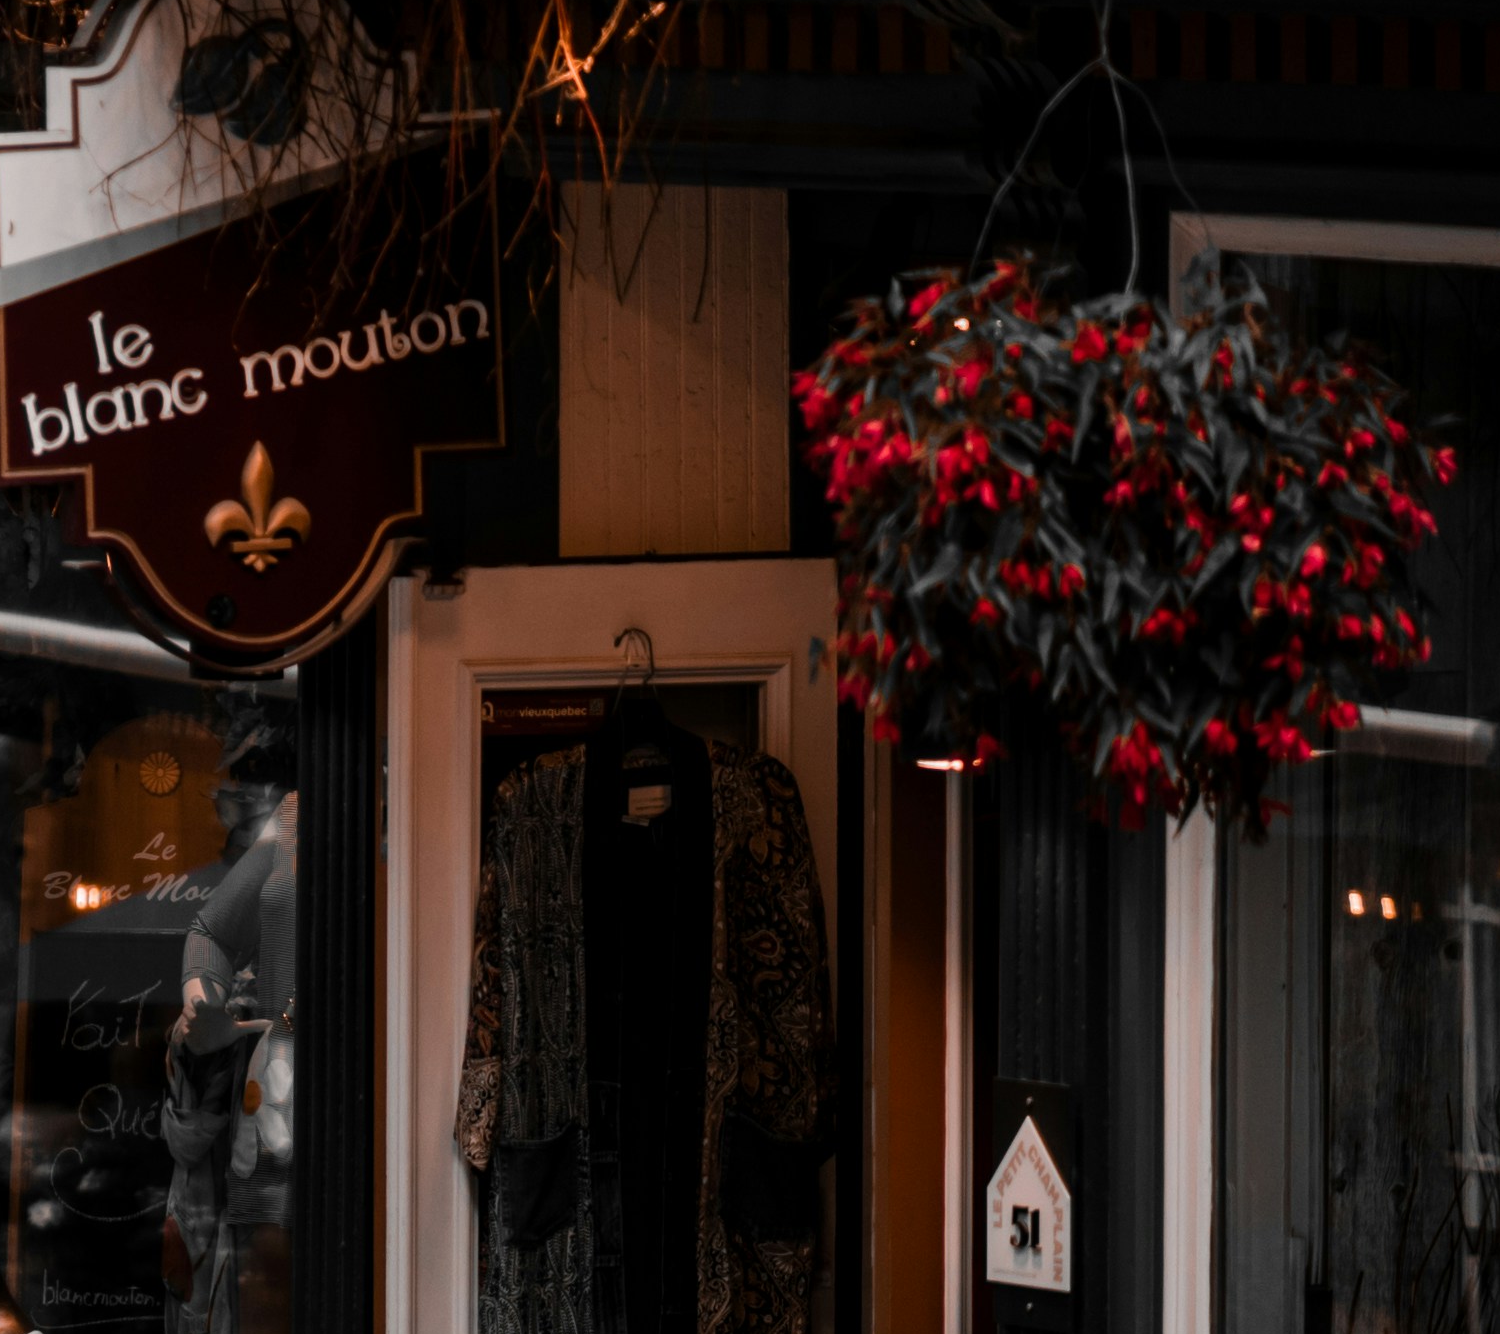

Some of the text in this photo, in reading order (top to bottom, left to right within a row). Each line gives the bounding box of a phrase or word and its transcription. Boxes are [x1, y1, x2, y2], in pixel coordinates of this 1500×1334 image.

[88, 309, 154, 375] le
[20, 298, 490, 456] blanc mouton
[132, 831, 177, 861] Le
[42, 870, 219, 903] Blnc Mou
[993, 1140, 1064, 1283] LE PETIT CHAMPLAIN
[1010, 1204, 1043, 1253] 51
